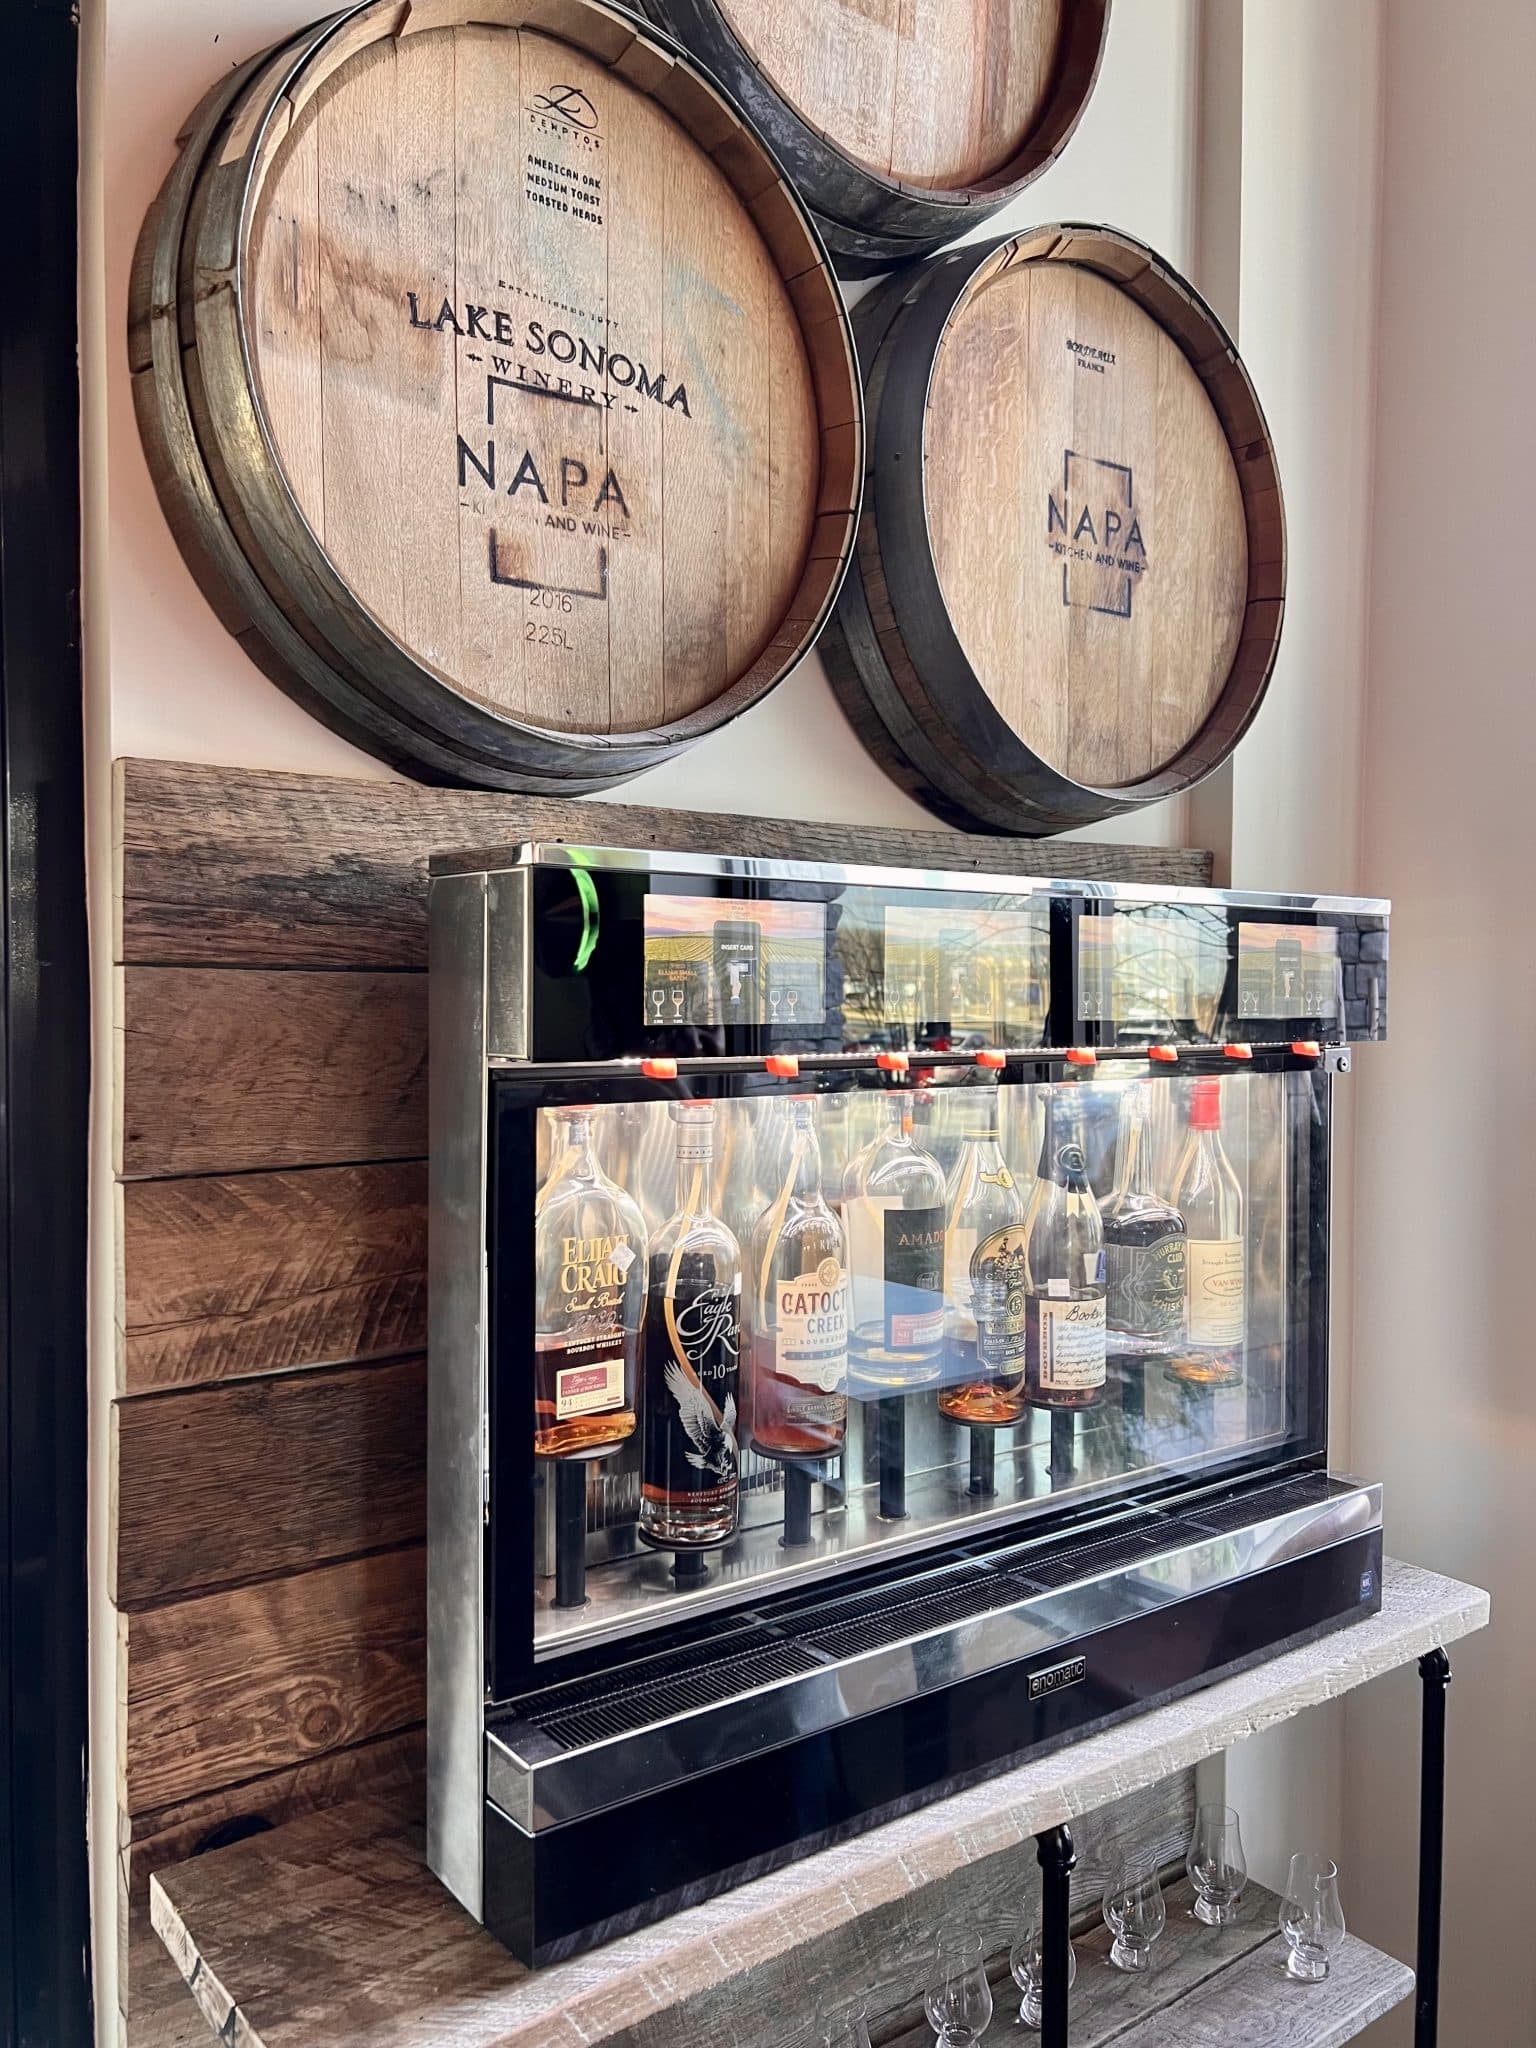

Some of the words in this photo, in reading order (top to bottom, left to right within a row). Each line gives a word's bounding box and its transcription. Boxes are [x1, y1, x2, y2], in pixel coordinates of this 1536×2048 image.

[527, 154, 579, 181] AMERICAN
[582, 175, 601, 190] OAK
[527, 172, 568, 195] MEDIUM
[571, 187, 601, 207] TOAST
[525, 189, 569, 213] TOASTED
[572, 206, 603, 225] HEADS
[406, 291, 515, 348] LAKE
[526, 321, 692, 419] SONOMA
[1077, 358, 1105, 375] FRANCE
[490, 354, 619, 410] WINERY
[456, 433, 631, 519] NAPA
[544, 516, 577, 532] AND
[1048, 493, 1147, 557] NAPA
[1095, 553, 1115, 567] AND
[529, 588, 573, 613] 2016
[525, 622, 574, 650] 225L
[782, 1288, 847, 1316] CATOCT
[807, 1314, 845, 1334] CREEK
[567, 1343, 595, 1355] BOURBON
[596, 1339, 623, 1349] WHISKEY
[713, 1363, 726, 1380] 10
[1031, 1662, 1084, 1692] enomatic
